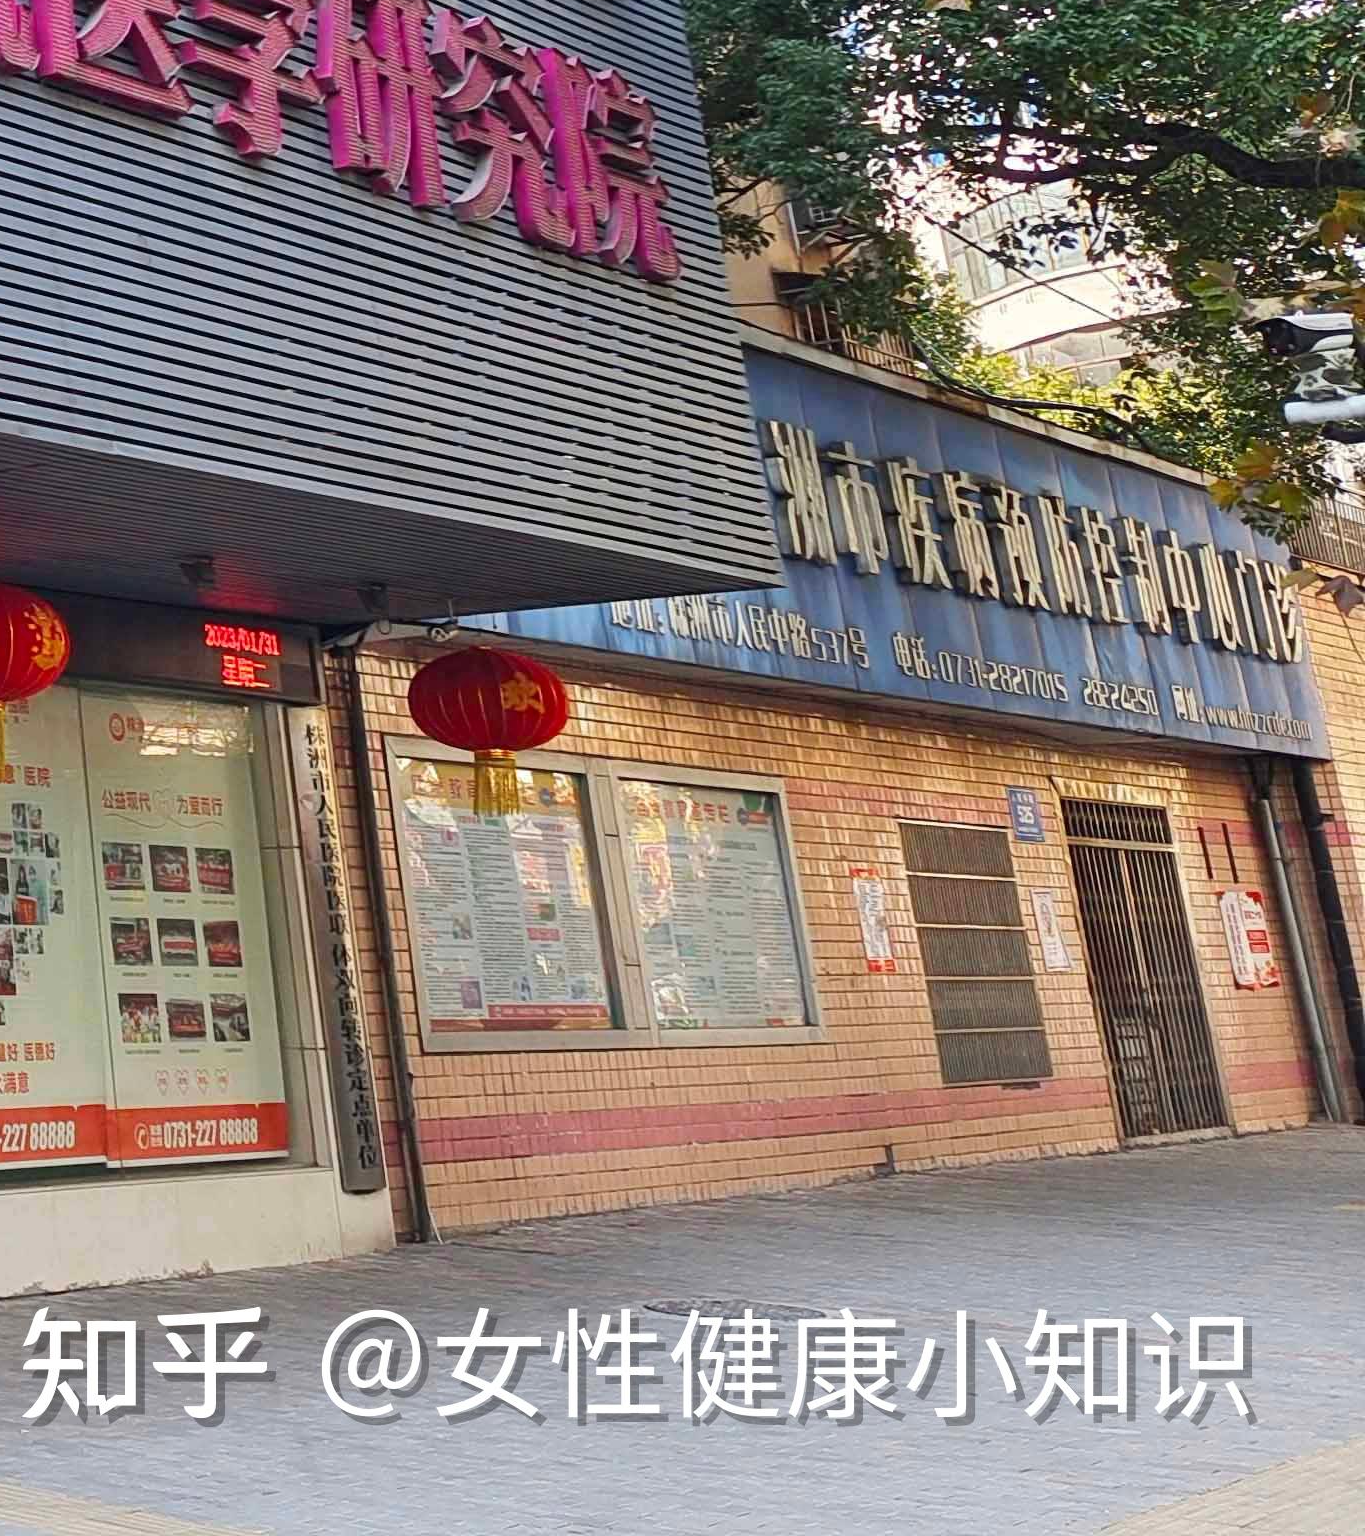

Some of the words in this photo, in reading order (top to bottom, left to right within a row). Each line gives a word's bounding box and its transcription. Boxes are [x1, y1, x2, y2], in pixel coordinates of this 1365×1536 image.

[204, 624, 281, 656] 2023/01/31
[221, 655, 271, 687] 星期二
[29, 1120, 76, 1150] 88888
[163, 1119, 218, 1148] 0731-227
[218, 1118, 259, 1145] 88888
